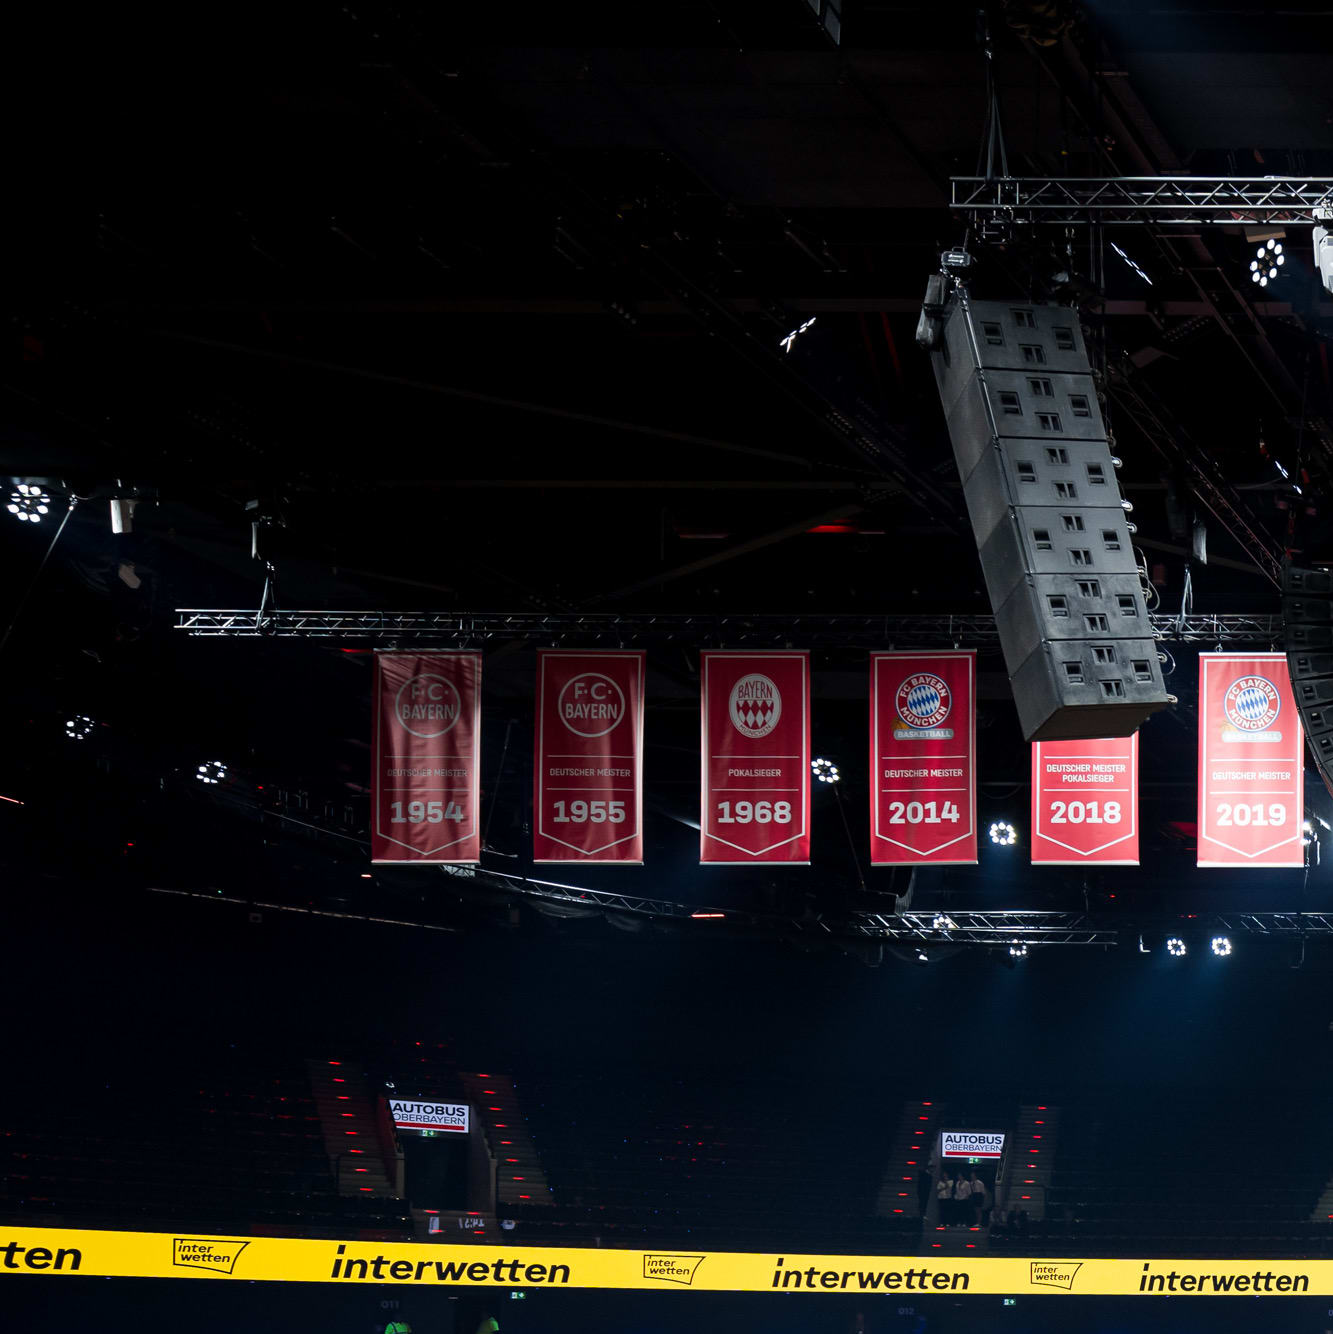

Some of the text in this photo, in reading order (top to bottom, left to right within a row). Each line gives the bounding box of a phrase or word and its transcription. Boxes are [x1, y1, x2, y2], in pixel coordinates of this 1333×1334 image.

[738, 680, 773, 699] BAYERN
[911, 676, 948, 697] BAYERN
[1239, 679, 1276, 701] BAYERN
[402, 703, 454, 720] BAYERN
[565, 703, 618, 720] BAYERN
[897, 730, 951, 738] BASKETBALL
[387, 768, 468, 777] DEUTSCHER MEISTER
[550, 768, 631, 777] DEUTSCHER MEISTER
[728, 768, 781, 777] POKALSIEGER
[884, 768, 963, 778] DEUTSCHER MEISTER
[1046, 764, 1126, 773] DEUTSCHER MEISTER
[1062, 774, 1114, 783] POKALSIEGER
[1212, 771, 1291, 781] DEUTSCHER MEISTER
[390, 801, 464, 823] 1954
[553, 801, 626, 823] 1955
[717, 801, 792, 824] 1968
[889, 801, 960, 824] 2014
[1050, 801, 1122, 824] 2018
[1216, 804, 1287, 826] 2019
[392, 1103, 465, 1117] AUTOBUS
[393, 1112, 466, 1125] OBERBAYERN
[945, 1134, 1002, 1145] AUTOBUS
[945, 1143, 1003, 1152] OBERBAYERN
[177, 1241, 215, 1255] inter
[180, 1252, 230, 1264] wetten
[647, 1256, 677, 1269] inter
[330, 1245, 571, 1285] interwetten
[650, 1265, 691, 1277] wetten
[1032, 1263, 1059, 1276] inter
[772, 1257, 970, 1291] interwetten
[1035, 1271, 1072, 1283] wetten
[1139, 1263, 1310, 1292] interwetten
